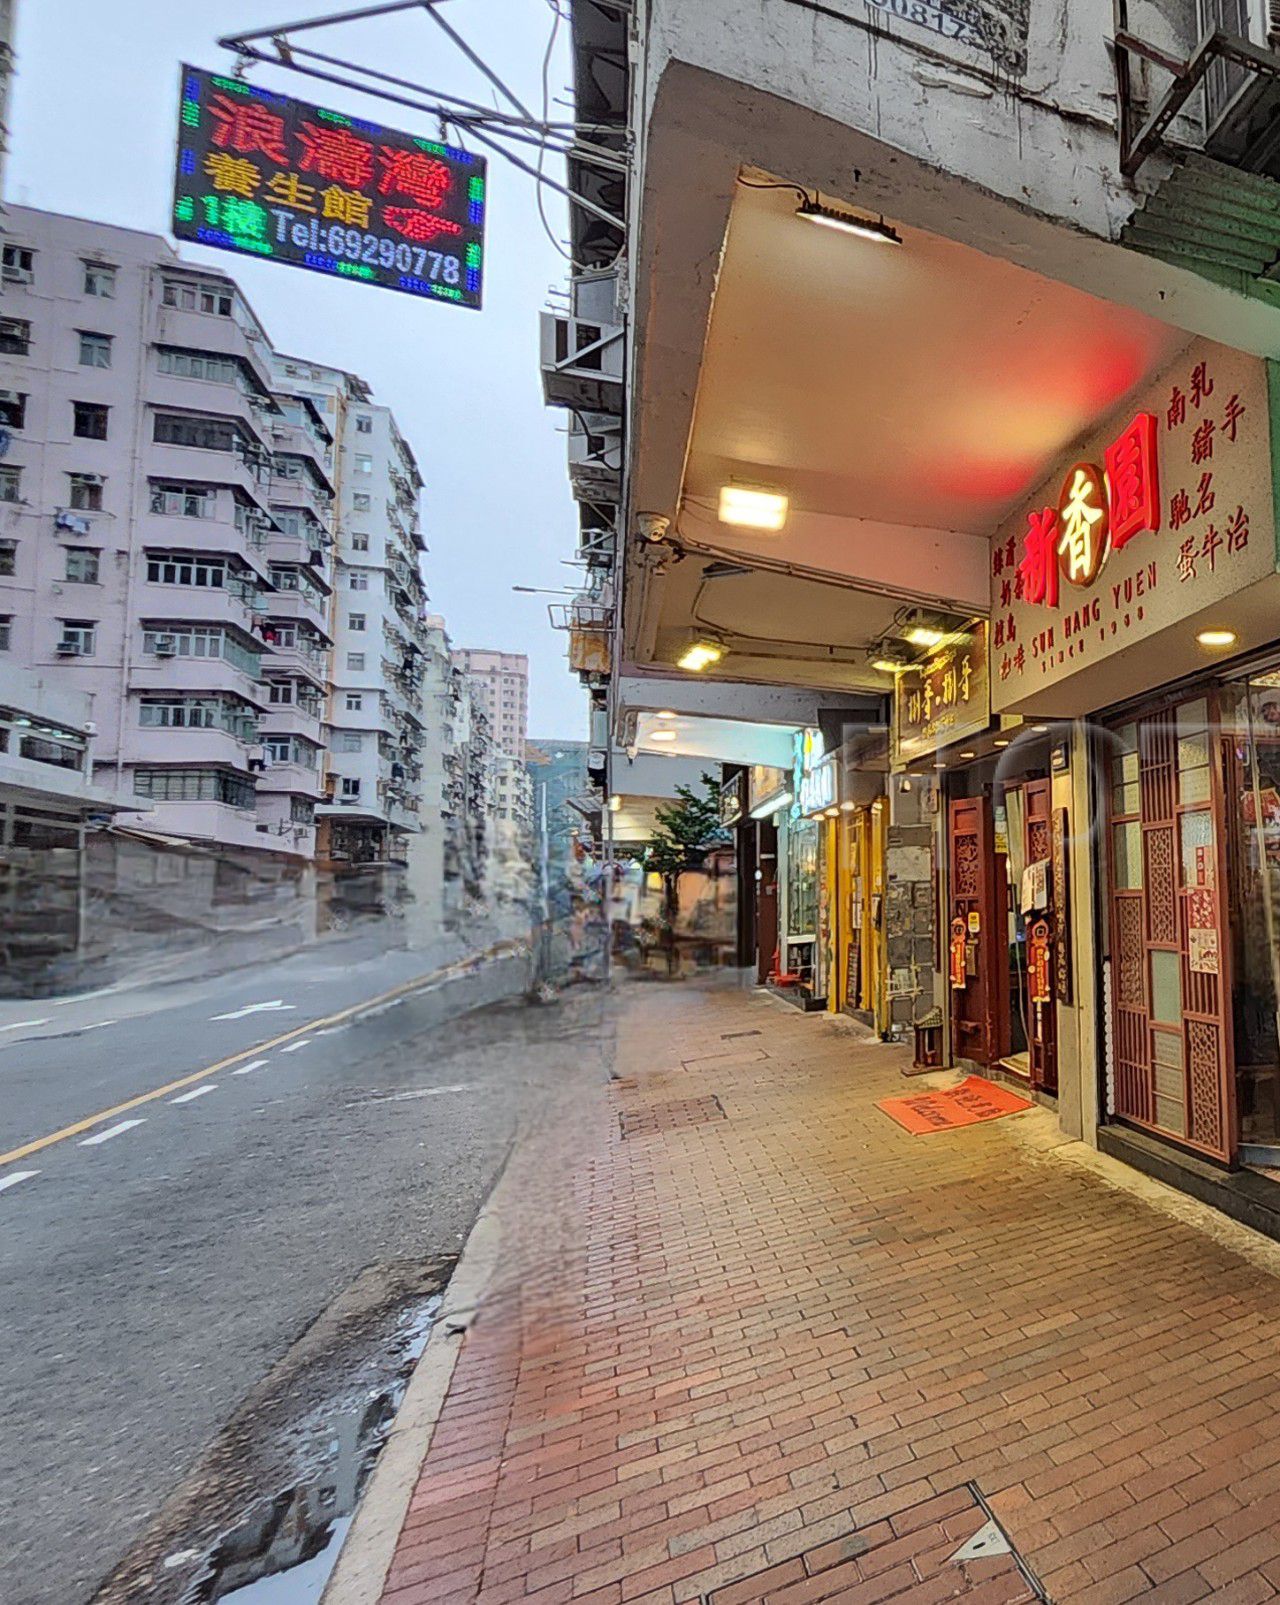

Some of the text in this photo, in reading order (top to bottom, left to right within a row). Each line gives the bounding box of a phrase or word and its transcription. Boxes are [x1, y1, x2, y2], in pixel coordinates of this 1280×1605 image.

[204, 152, 373, 229] 養生館
[207, 92, 452, 209] 浪濤灣
[269, 210, 461, 285] Tel:69290778
[1020, 413, 1160, 608] 新香園
[1176, 506, 1250, 582] 蛋牛治
[1032, 627, 1054, 658] SUN
[1064, 597, 1100, 639] HANG
[1112, 561, 1157, 609] YUEN
